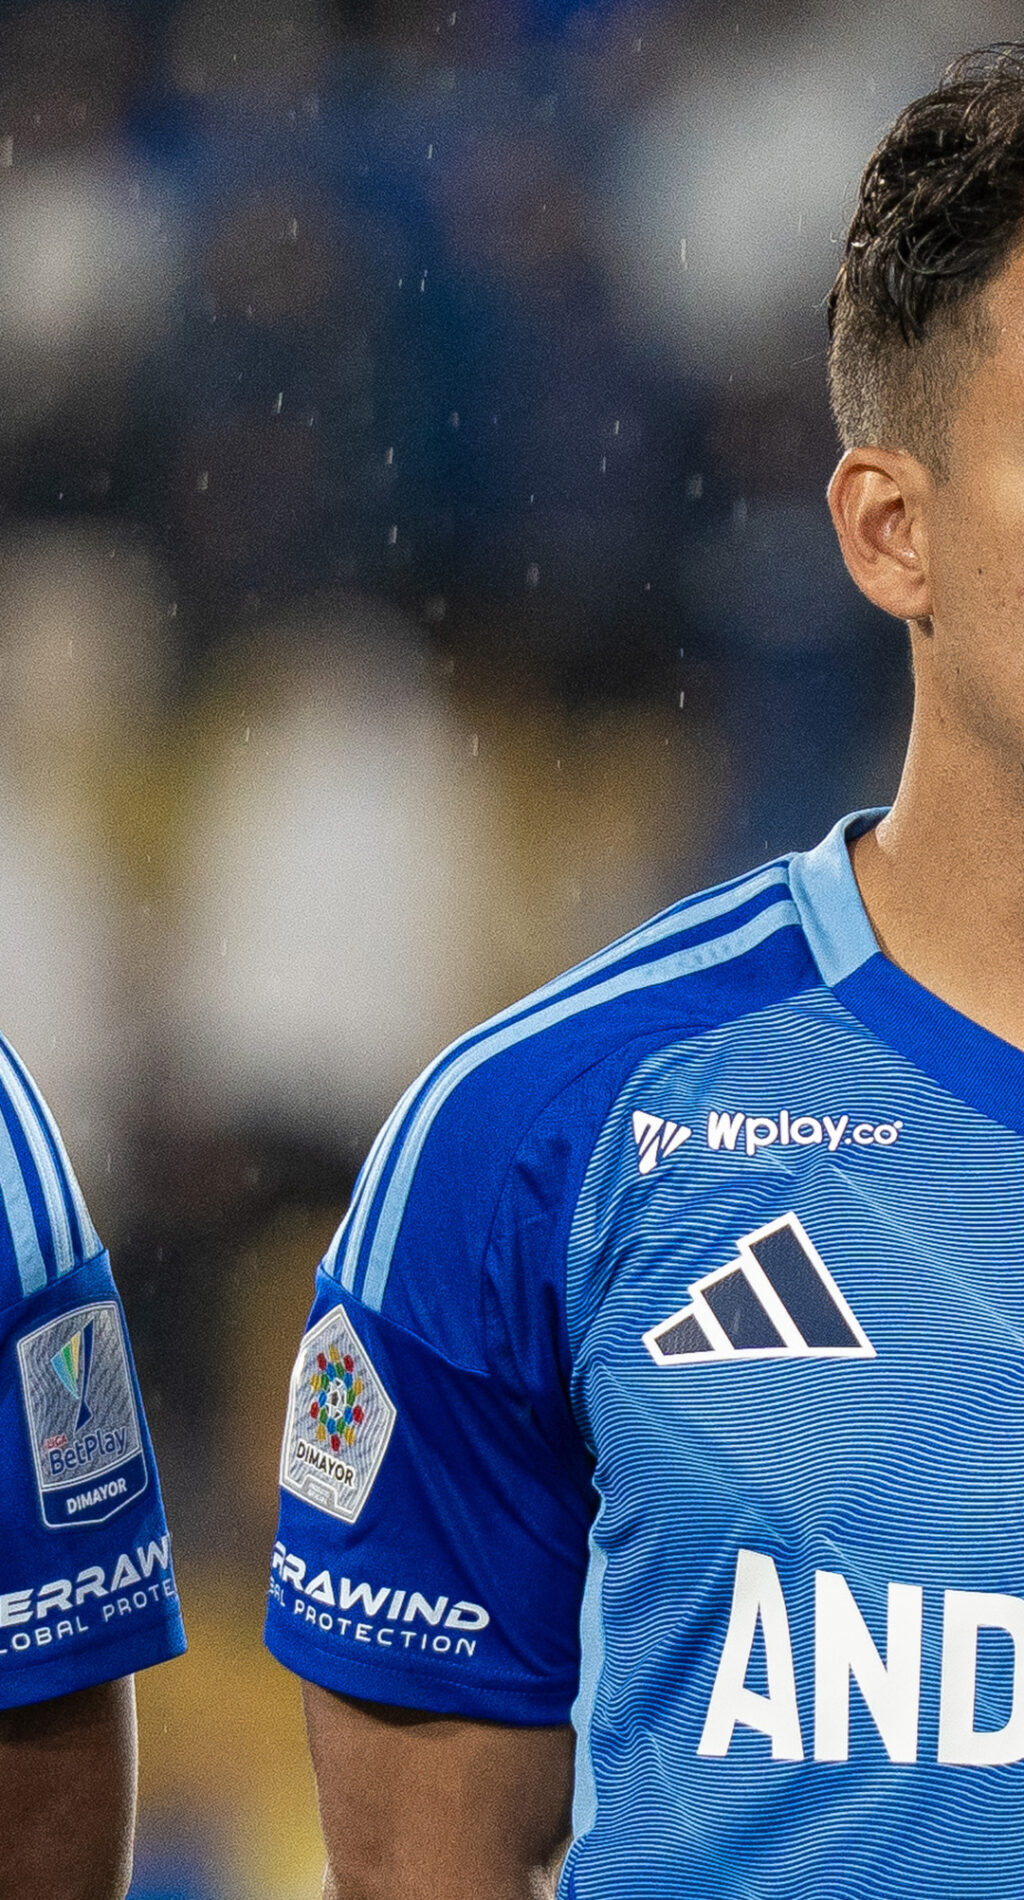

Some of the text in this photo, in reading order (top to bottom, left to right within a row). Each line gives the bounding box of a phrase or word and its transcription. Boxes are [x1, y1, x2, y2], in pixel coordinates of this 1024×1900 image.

[49, 1427, 127, 1475] BetPlay
[296, 1441, 354, 1487] DIMAYOR
[66, 1477, 127, 1515] DIMAYOR
[0, 1616, 89, 1655] OBAL
[294, 1599, 476, 1657] PROTECTION
